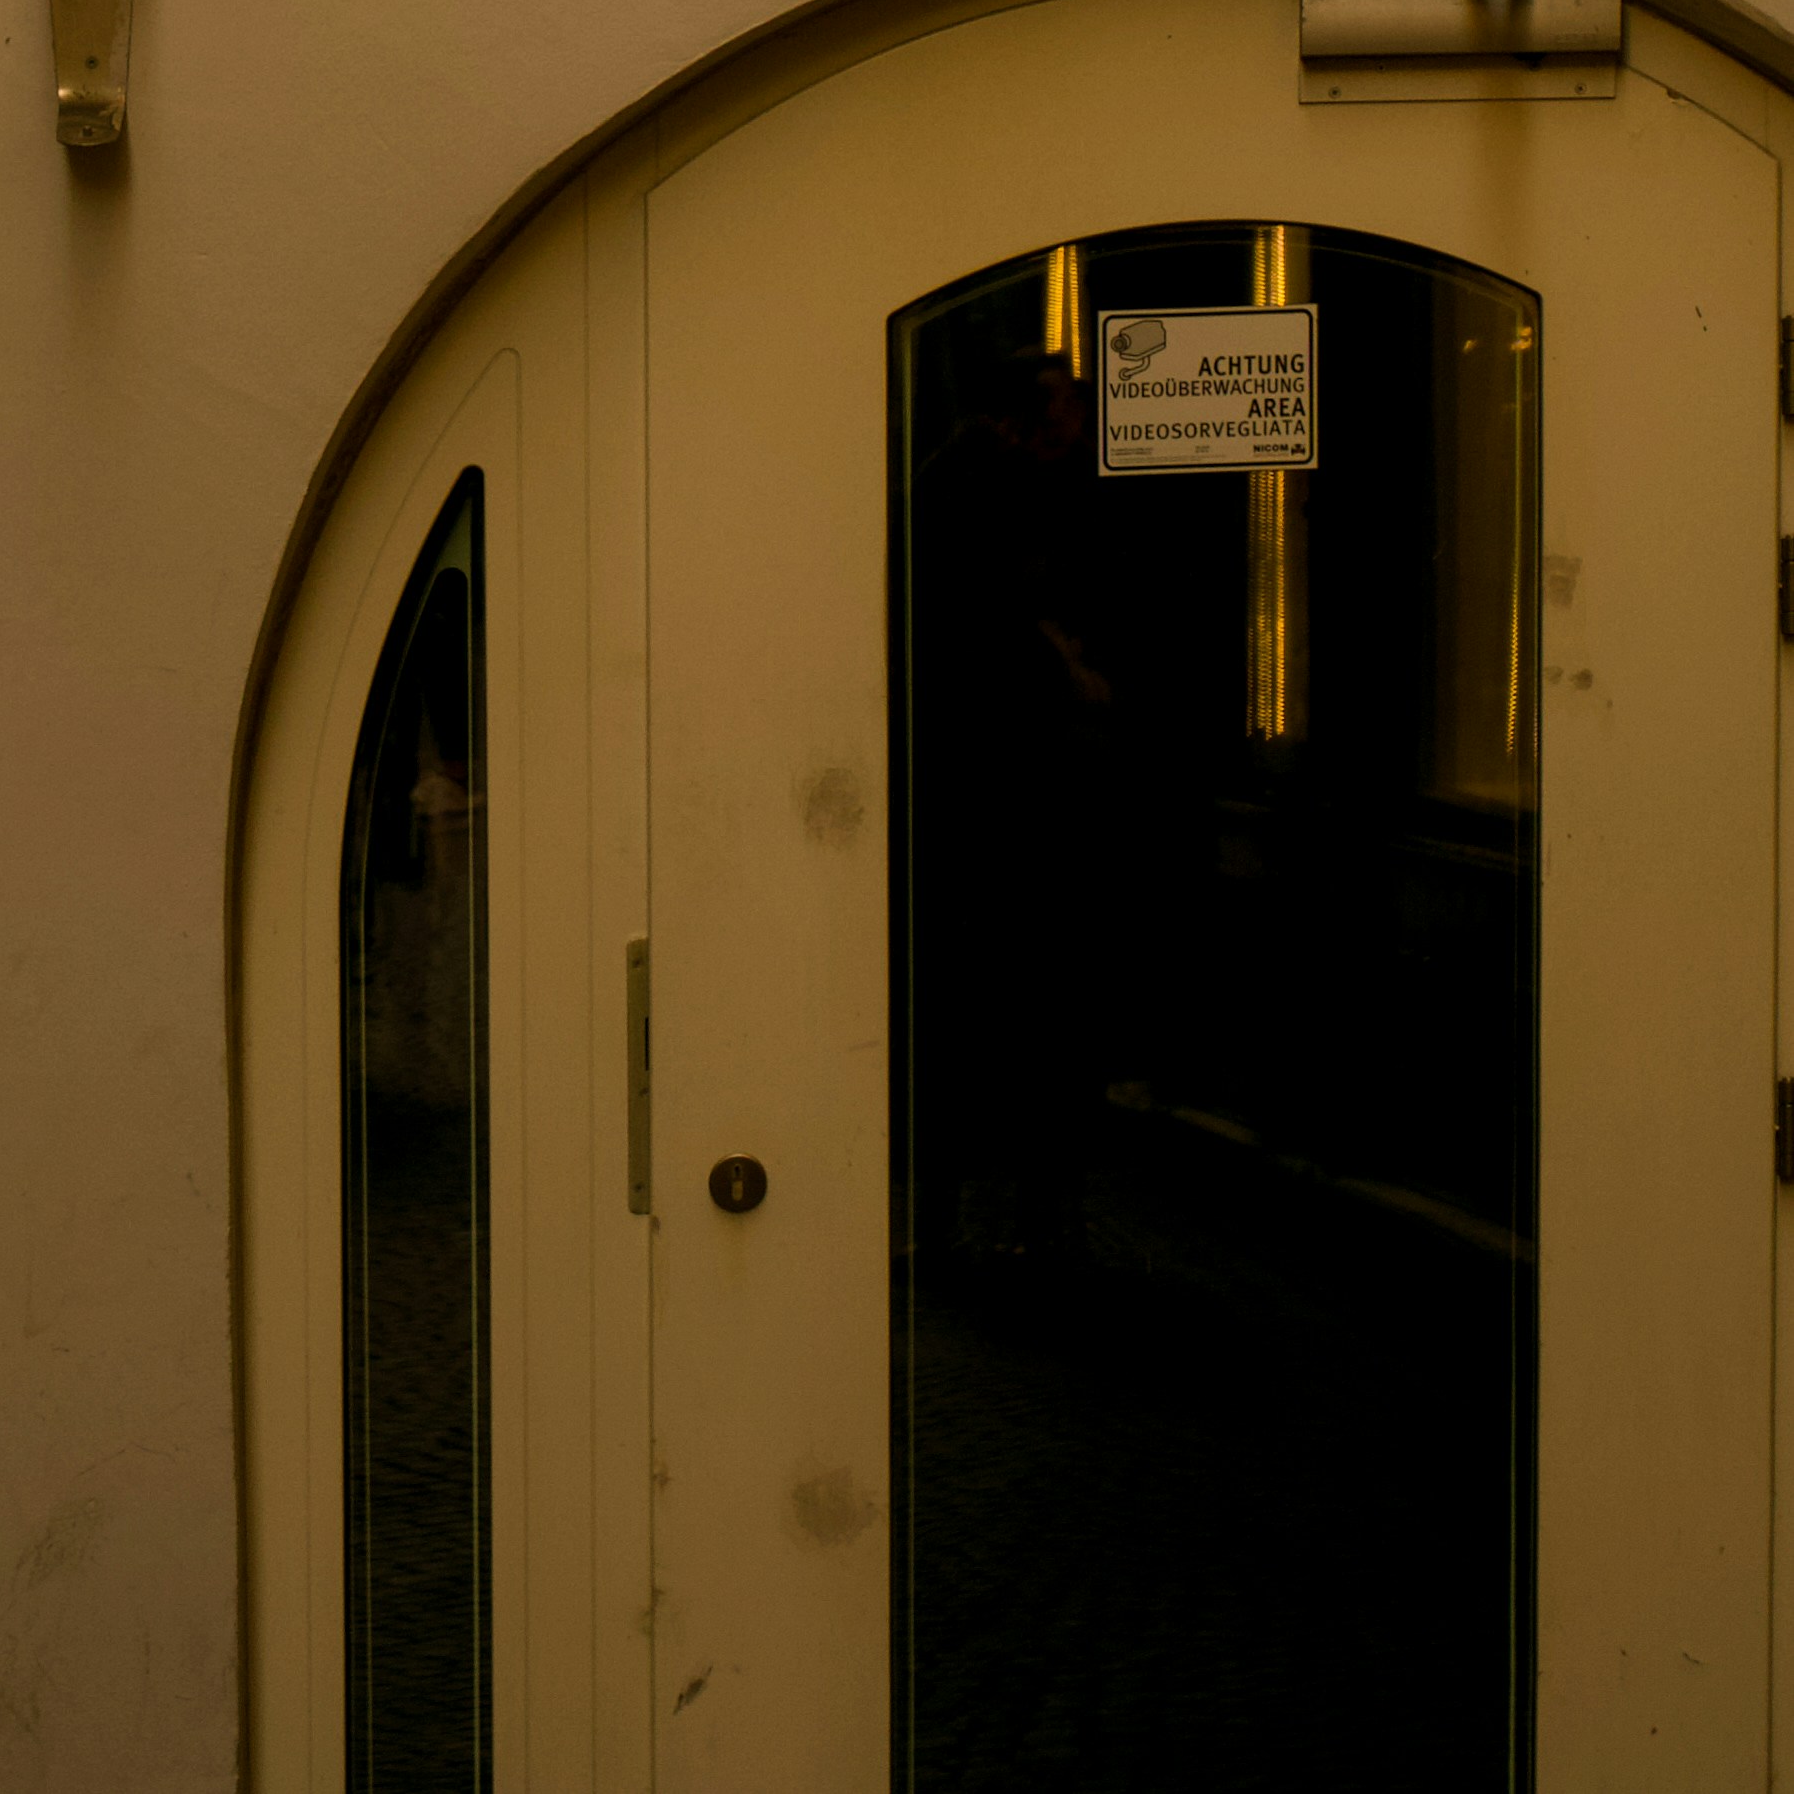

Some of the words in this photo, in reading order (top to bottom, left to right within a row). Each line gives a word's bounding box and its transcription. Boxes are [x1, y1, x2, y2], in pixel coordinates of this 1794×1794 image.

[1198, 353, 1305, 377] ACHTUNG
[1109, 376, 1305, 399] VIDEOÜBERWACHUNG
[1248, 397, 1306, 418] AREA
[1109, 419, 1306, 441] VIDEOSORVEGLIATA
[1253, 443, 1289, 452] NICOM
